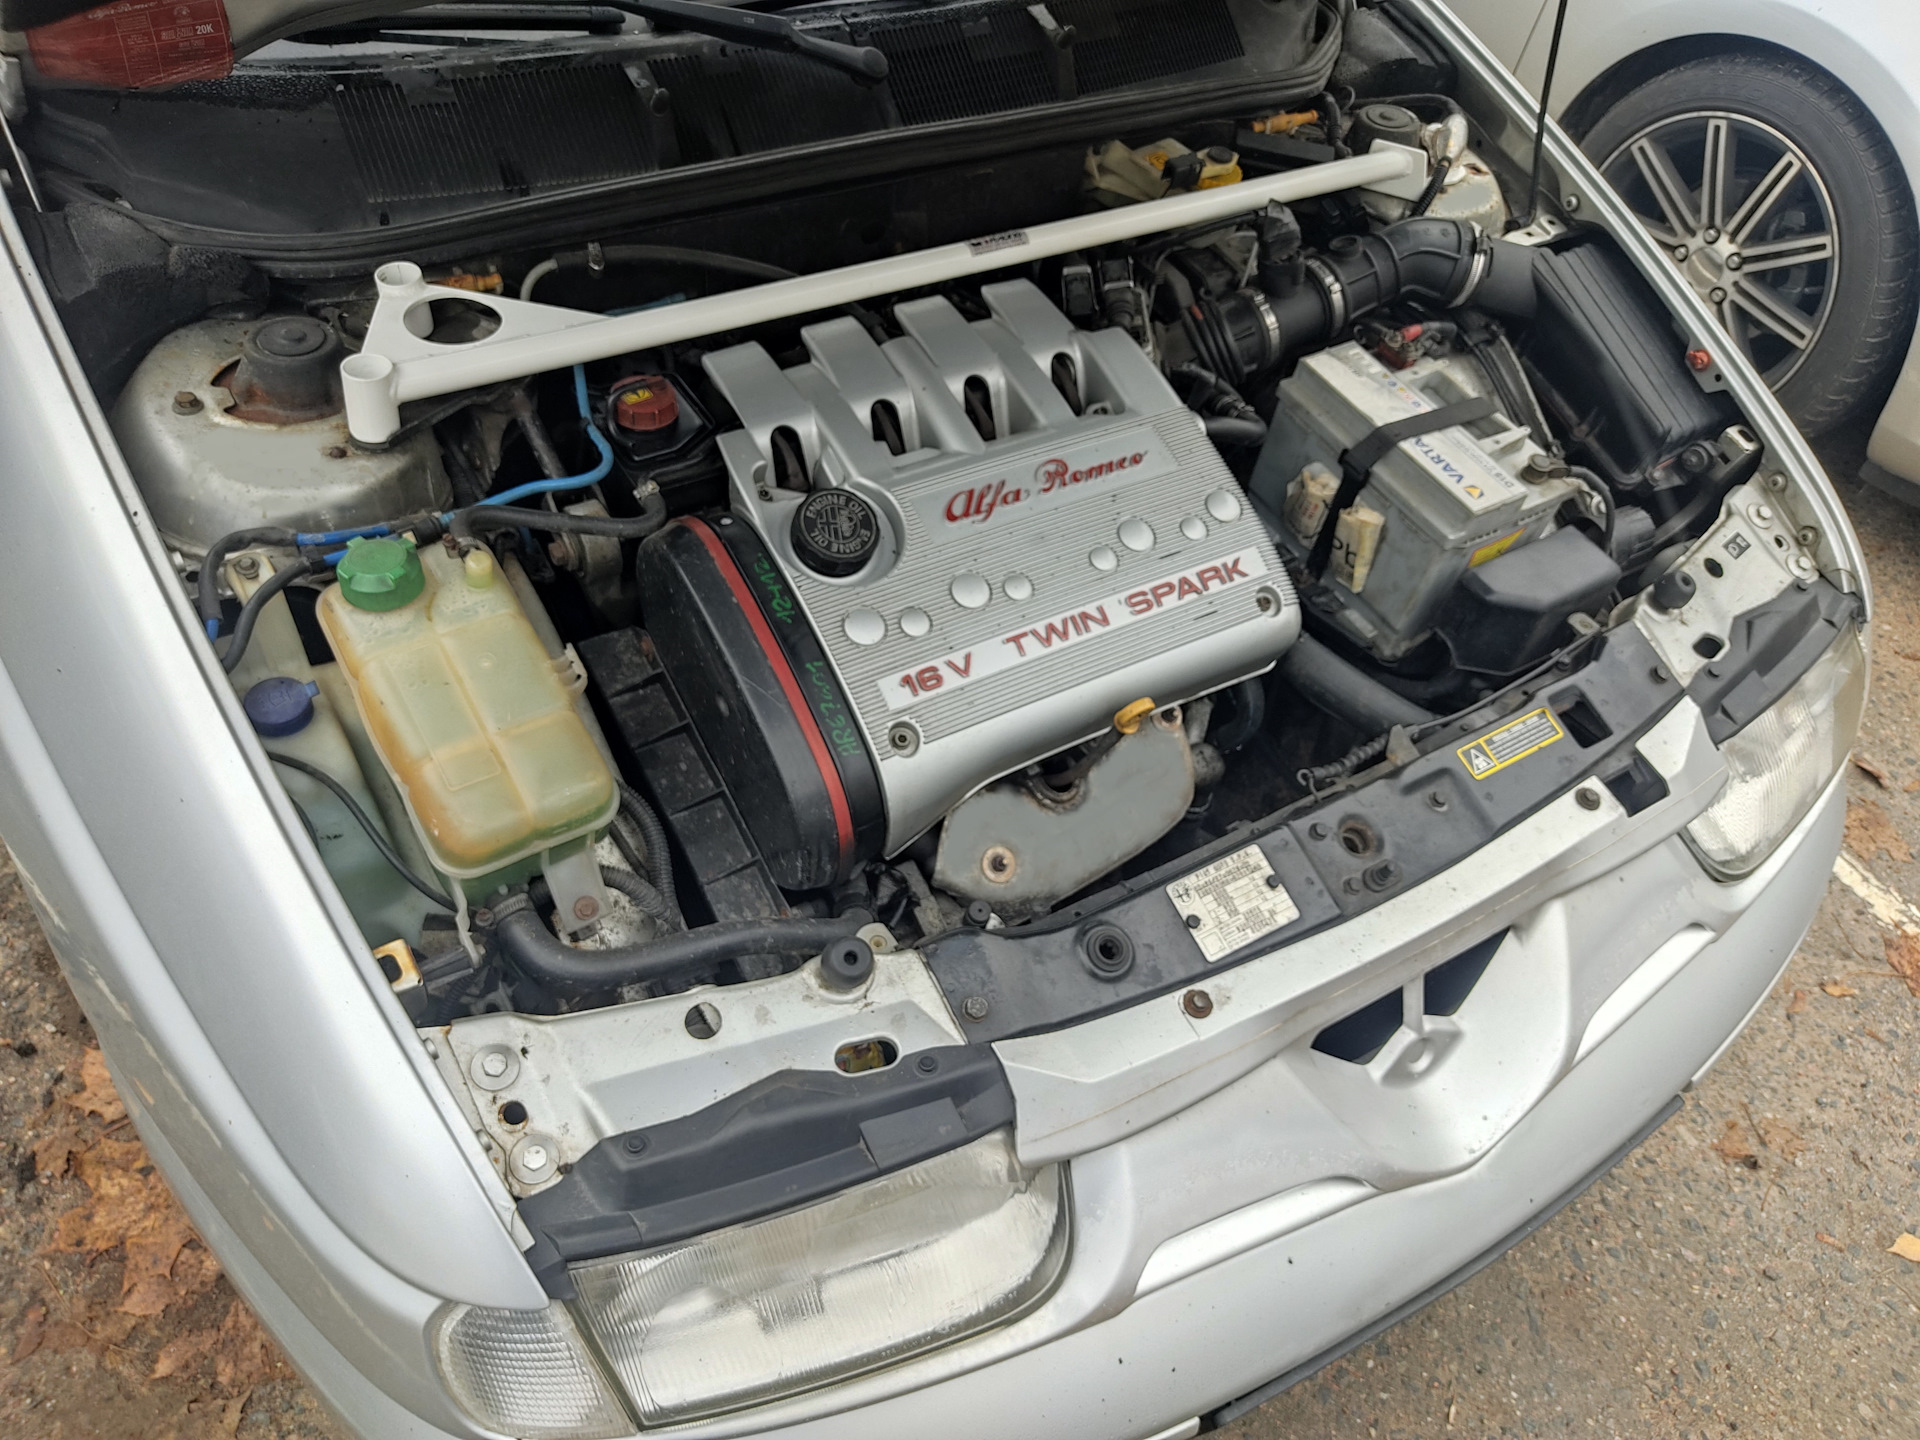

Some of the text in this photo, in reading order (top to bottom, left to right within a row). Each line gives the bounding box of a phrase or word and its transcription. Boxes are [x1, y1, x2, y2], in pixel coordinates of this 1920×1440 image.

[195, 23, 215, 36] 20K
[1414, 437, 1464, 484] VARTA
[944, 451, 1148, 525] Alfa Romeo
[806, 494, 867, 520] ENGINE OIL
[810, 527, 871, 554] ENGINE OIL
[1003, 606, 1111, 656] TWIN
[1124, 557, 1250, 616] SPARK
